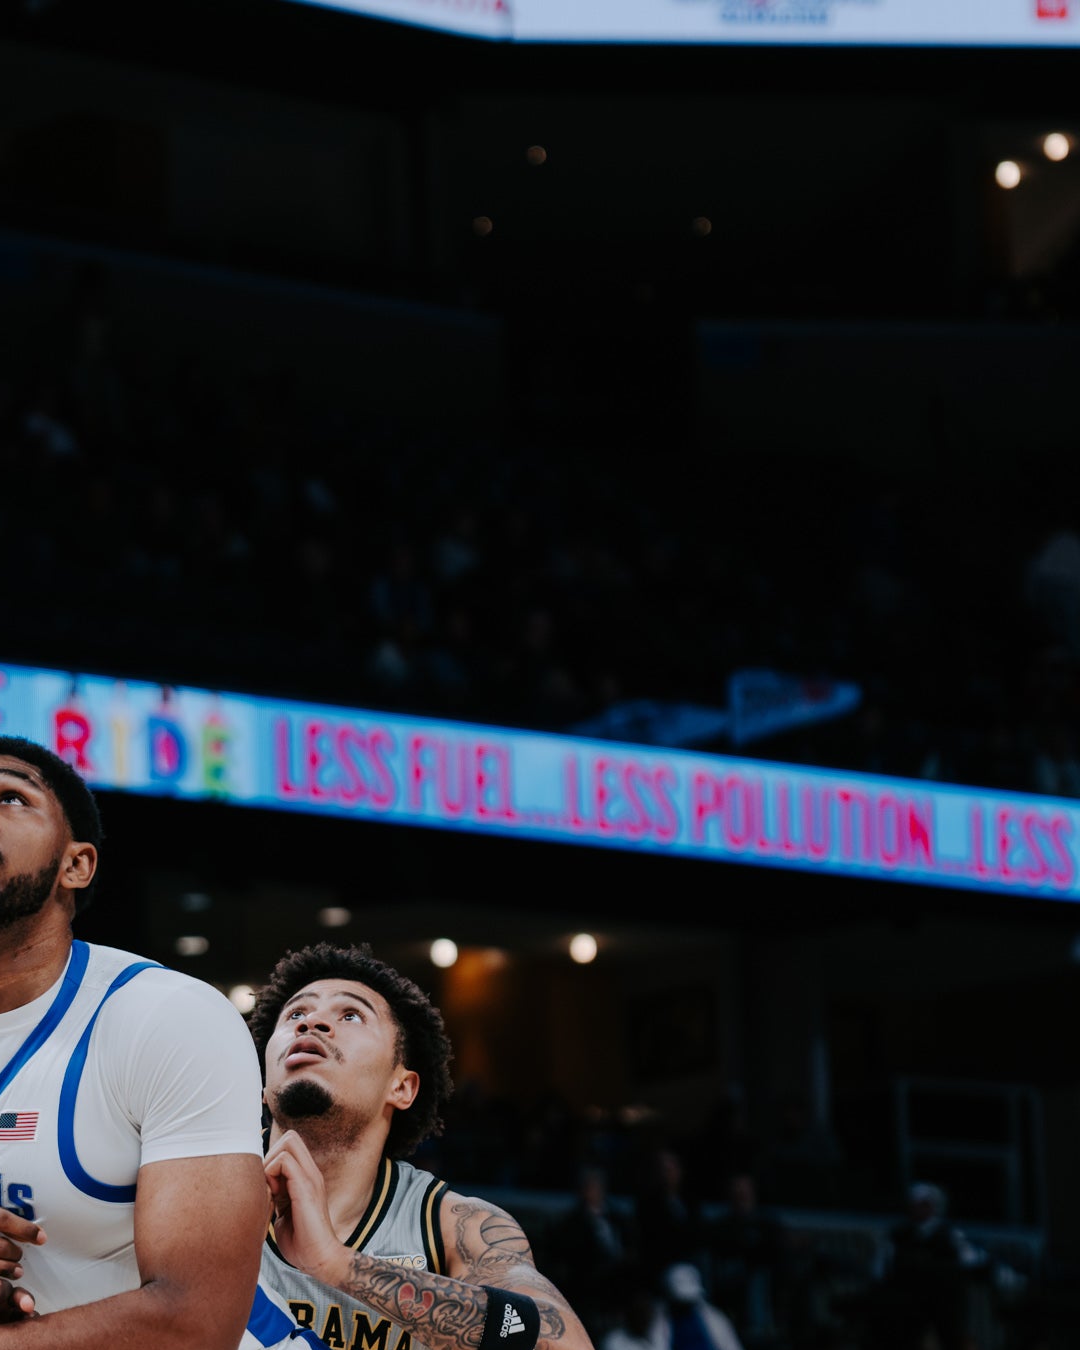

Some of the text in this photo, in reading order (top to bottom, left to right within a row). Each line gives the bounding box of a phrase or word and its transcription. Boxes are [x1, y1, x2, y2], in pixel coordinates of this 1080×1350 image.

[54, 704, 242, 798] RIDE
[273, 713, 399, 810] LESS
[500, 1303, 513, 1338] adidas
